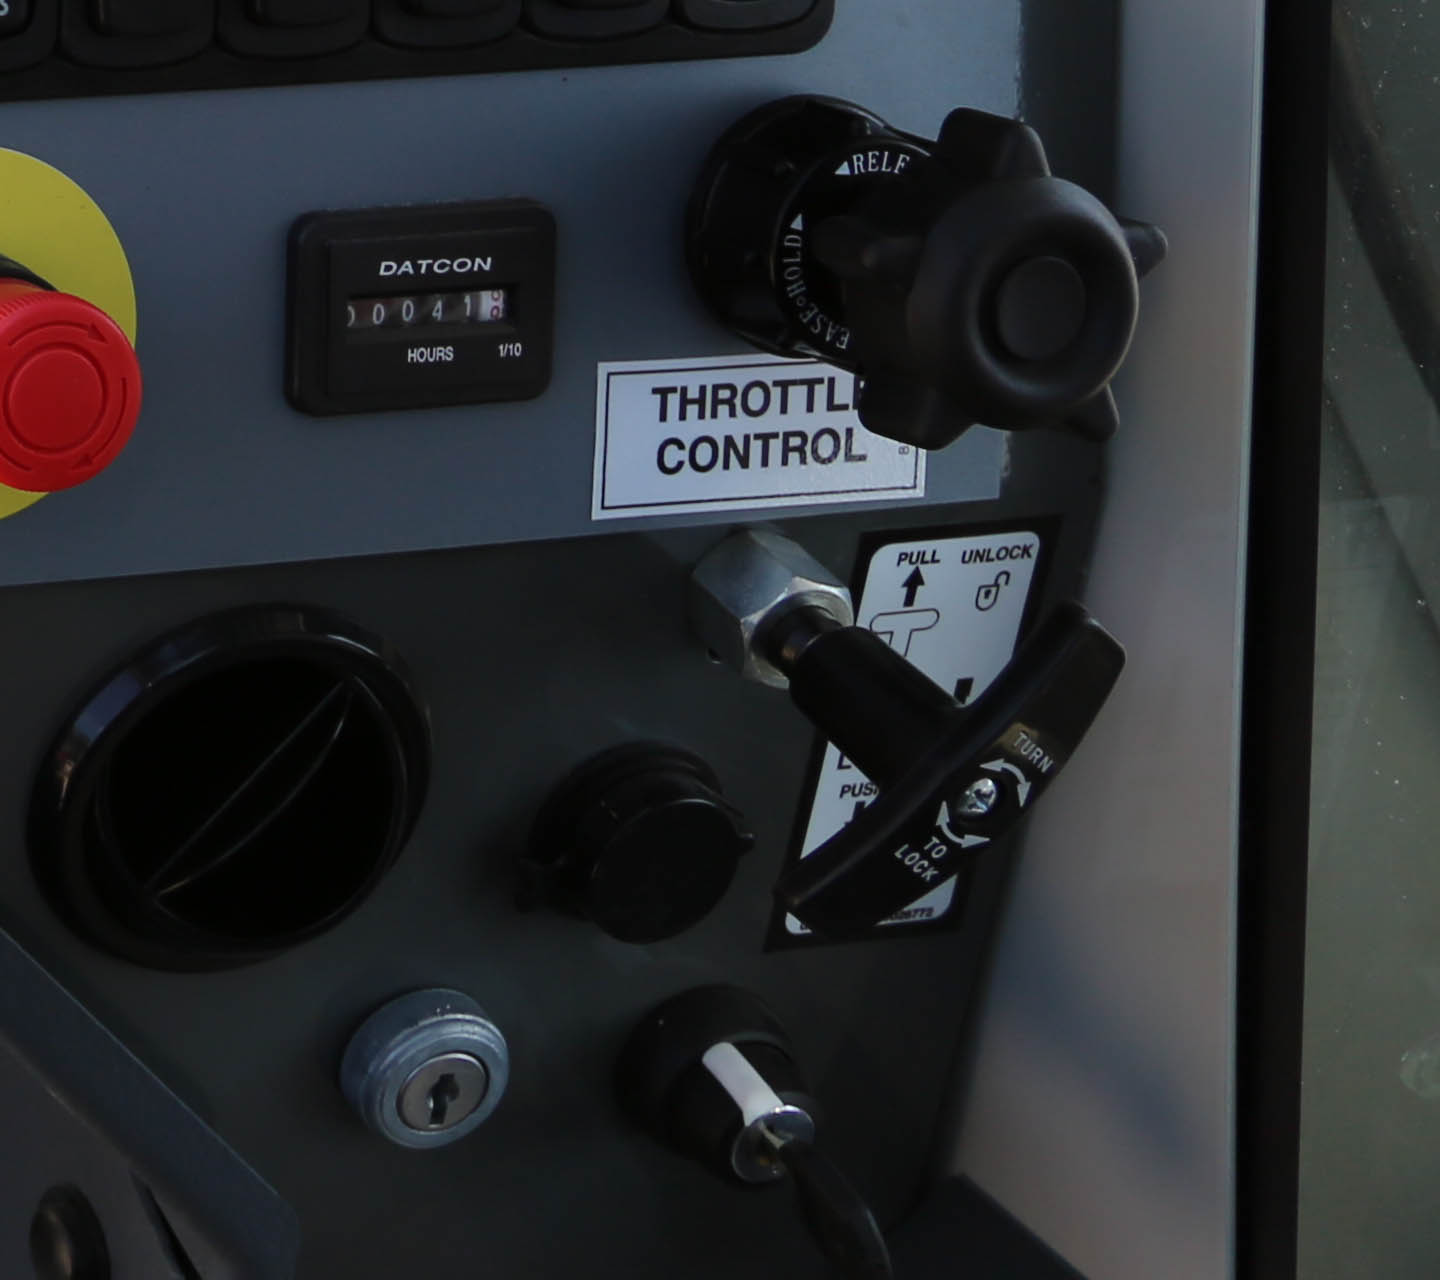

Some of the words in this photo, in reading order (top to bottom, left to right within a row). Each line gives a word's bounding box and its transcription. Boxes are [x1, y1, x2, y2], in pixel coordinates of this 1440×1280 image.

[379, 256, 492, 276] DATCON
[783, 234, 807, 298] HOLD
[407, 346, 454, 363] HOURS
[498, 342, 522, 358] 1/10
[655, 427, 868, 476] CONTROL
[896, 549, 941, 568] PULL
[960, 543, 1035, 566] UNLOCK
[1013, 731, 1055, 774] TURN
[893, 843, 941, 882] LOCK
[923, 836, 948, 860] TO
